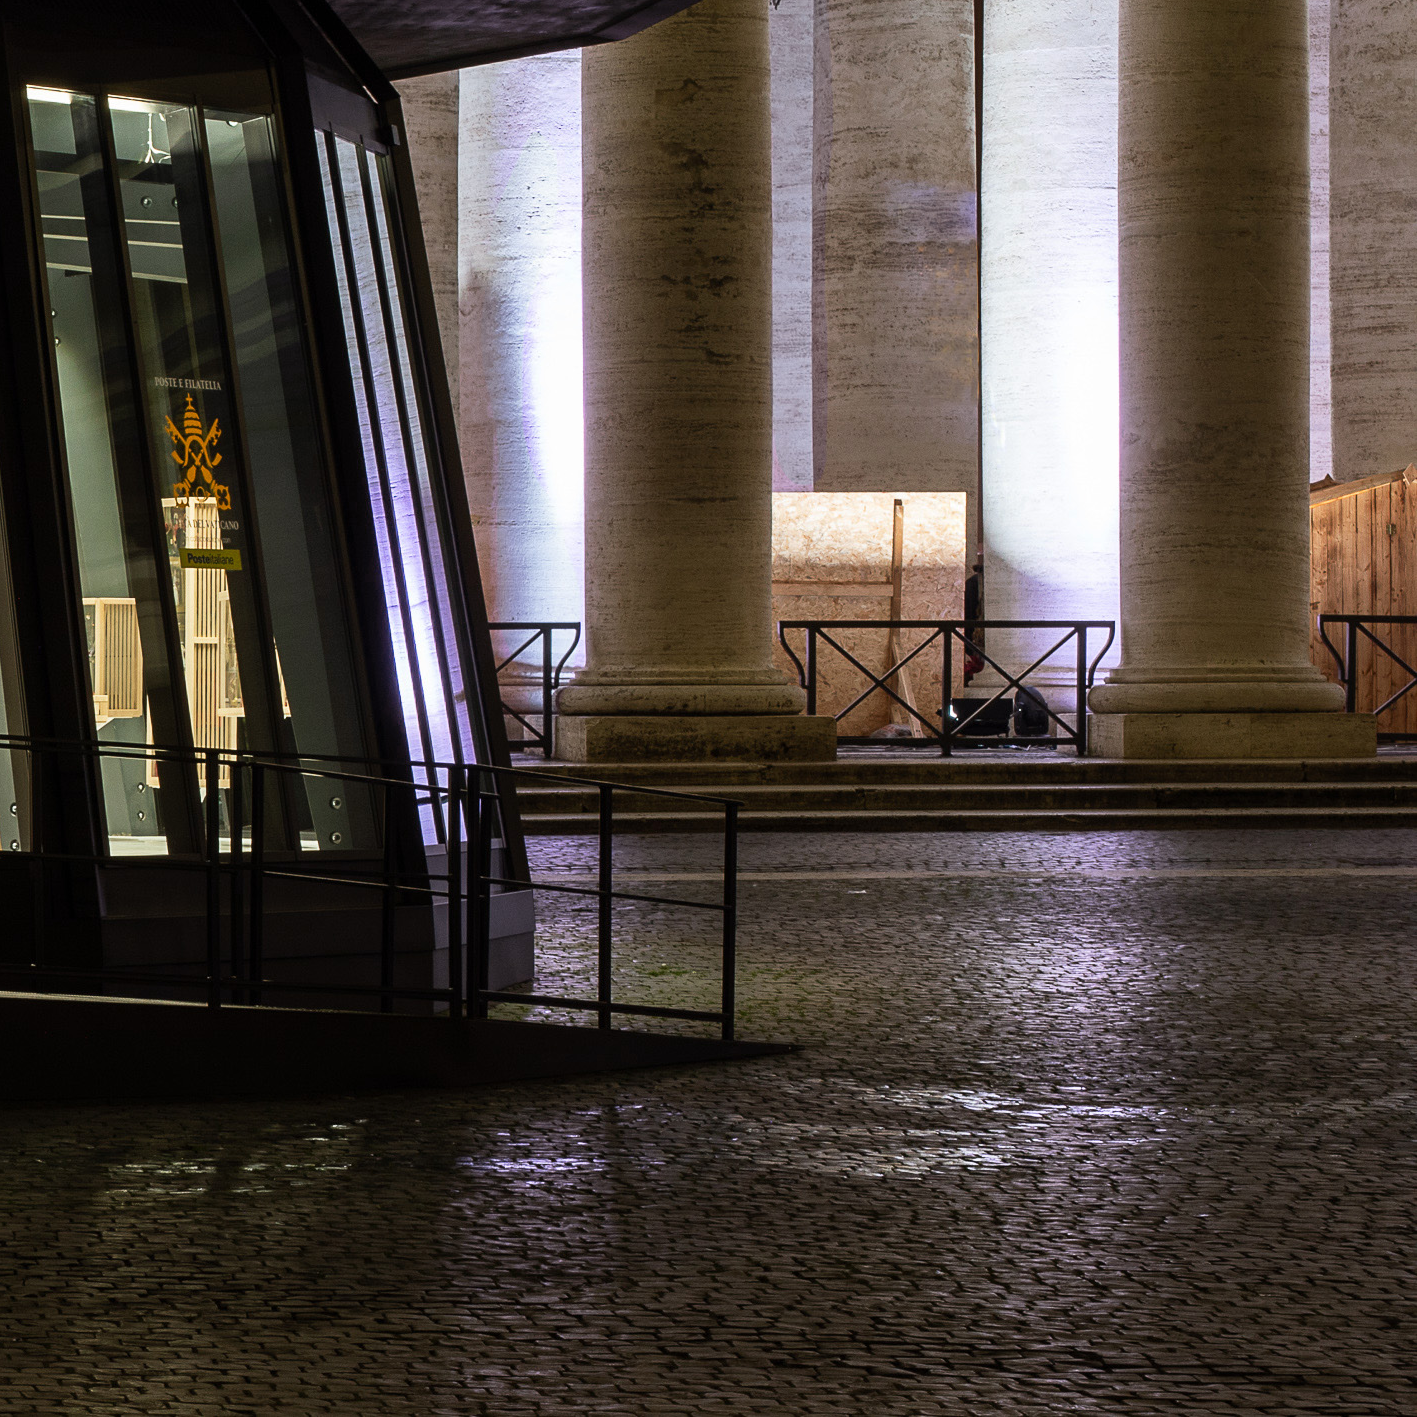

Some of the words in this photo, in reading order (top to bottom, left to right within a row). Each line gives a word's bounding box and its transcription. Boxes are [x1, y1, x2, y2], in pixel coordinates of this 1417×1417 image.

[154, 376, 178, 388] POSTE
[179, 378, 184, 388] E
[185, 378, 222, 391] FILATELIA
[187, 553, 234, 565] Posteitaliane
